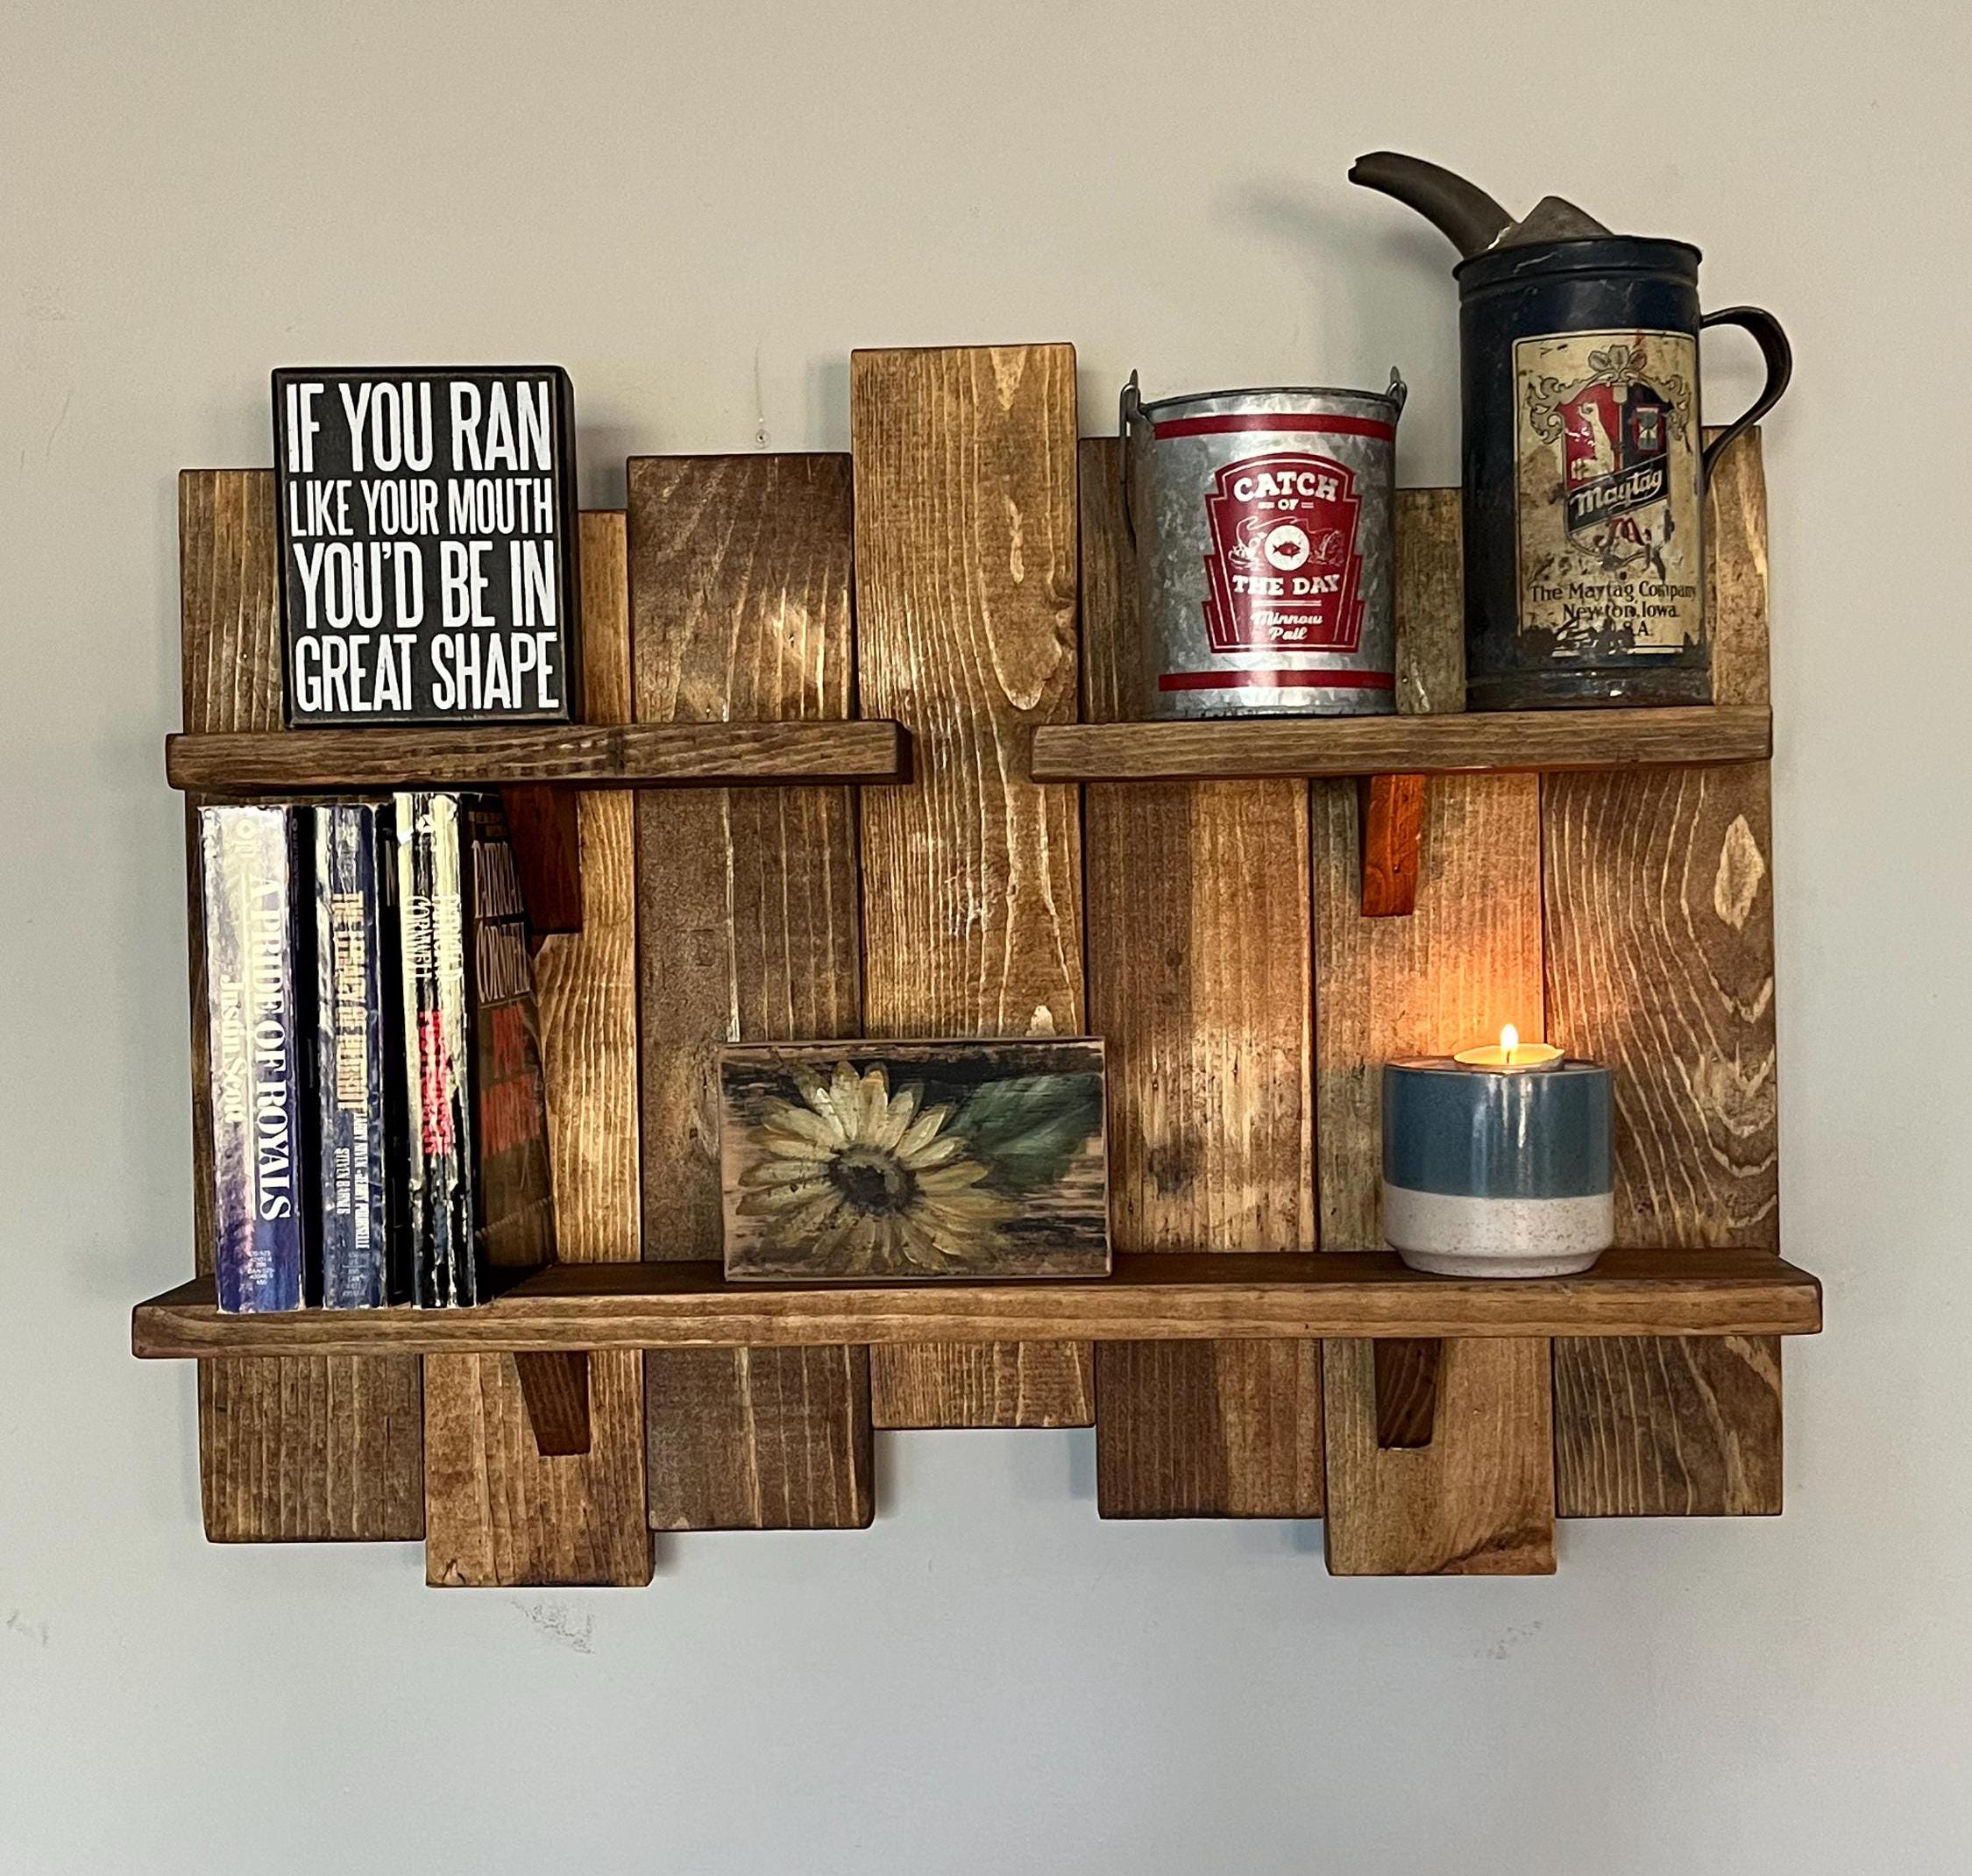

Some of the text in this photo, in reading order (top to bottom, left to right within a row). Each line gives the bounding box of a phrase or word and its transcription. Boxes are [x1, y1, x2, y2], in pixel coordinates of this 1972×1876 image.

[287, 380, 552, 473] IF YOU RAN
[289, 478, 554, 537] LIKE YOUR MOUTH
[1233, 471, 1339, 502] CATCH
[1278, 498, 1299, 510] OF
[1570, 468, 1663, 516] Maytag
[292, 540, 557, 629] YOU'D BE IN
[1232, 574, 1340, 596] THE DAY
[1531, 579, 1696, 604] The Maytag Company
[1250, 610, 1323, 625] Minnow
[1268, 627, 1307, 641] Pail
[294, 631, 559, 713] GREAT SHAPE
[249, 873, 282, 897] A
[249, 909, 286, 1015] PRIDE
[219, 974, 247, 1124] Justin Scott
[253, 1019, 287, 1072] OF
[255, 1080, 291, 1221] ROYALS
[335, 1147, 351, 1214] STEVEN BARNES
